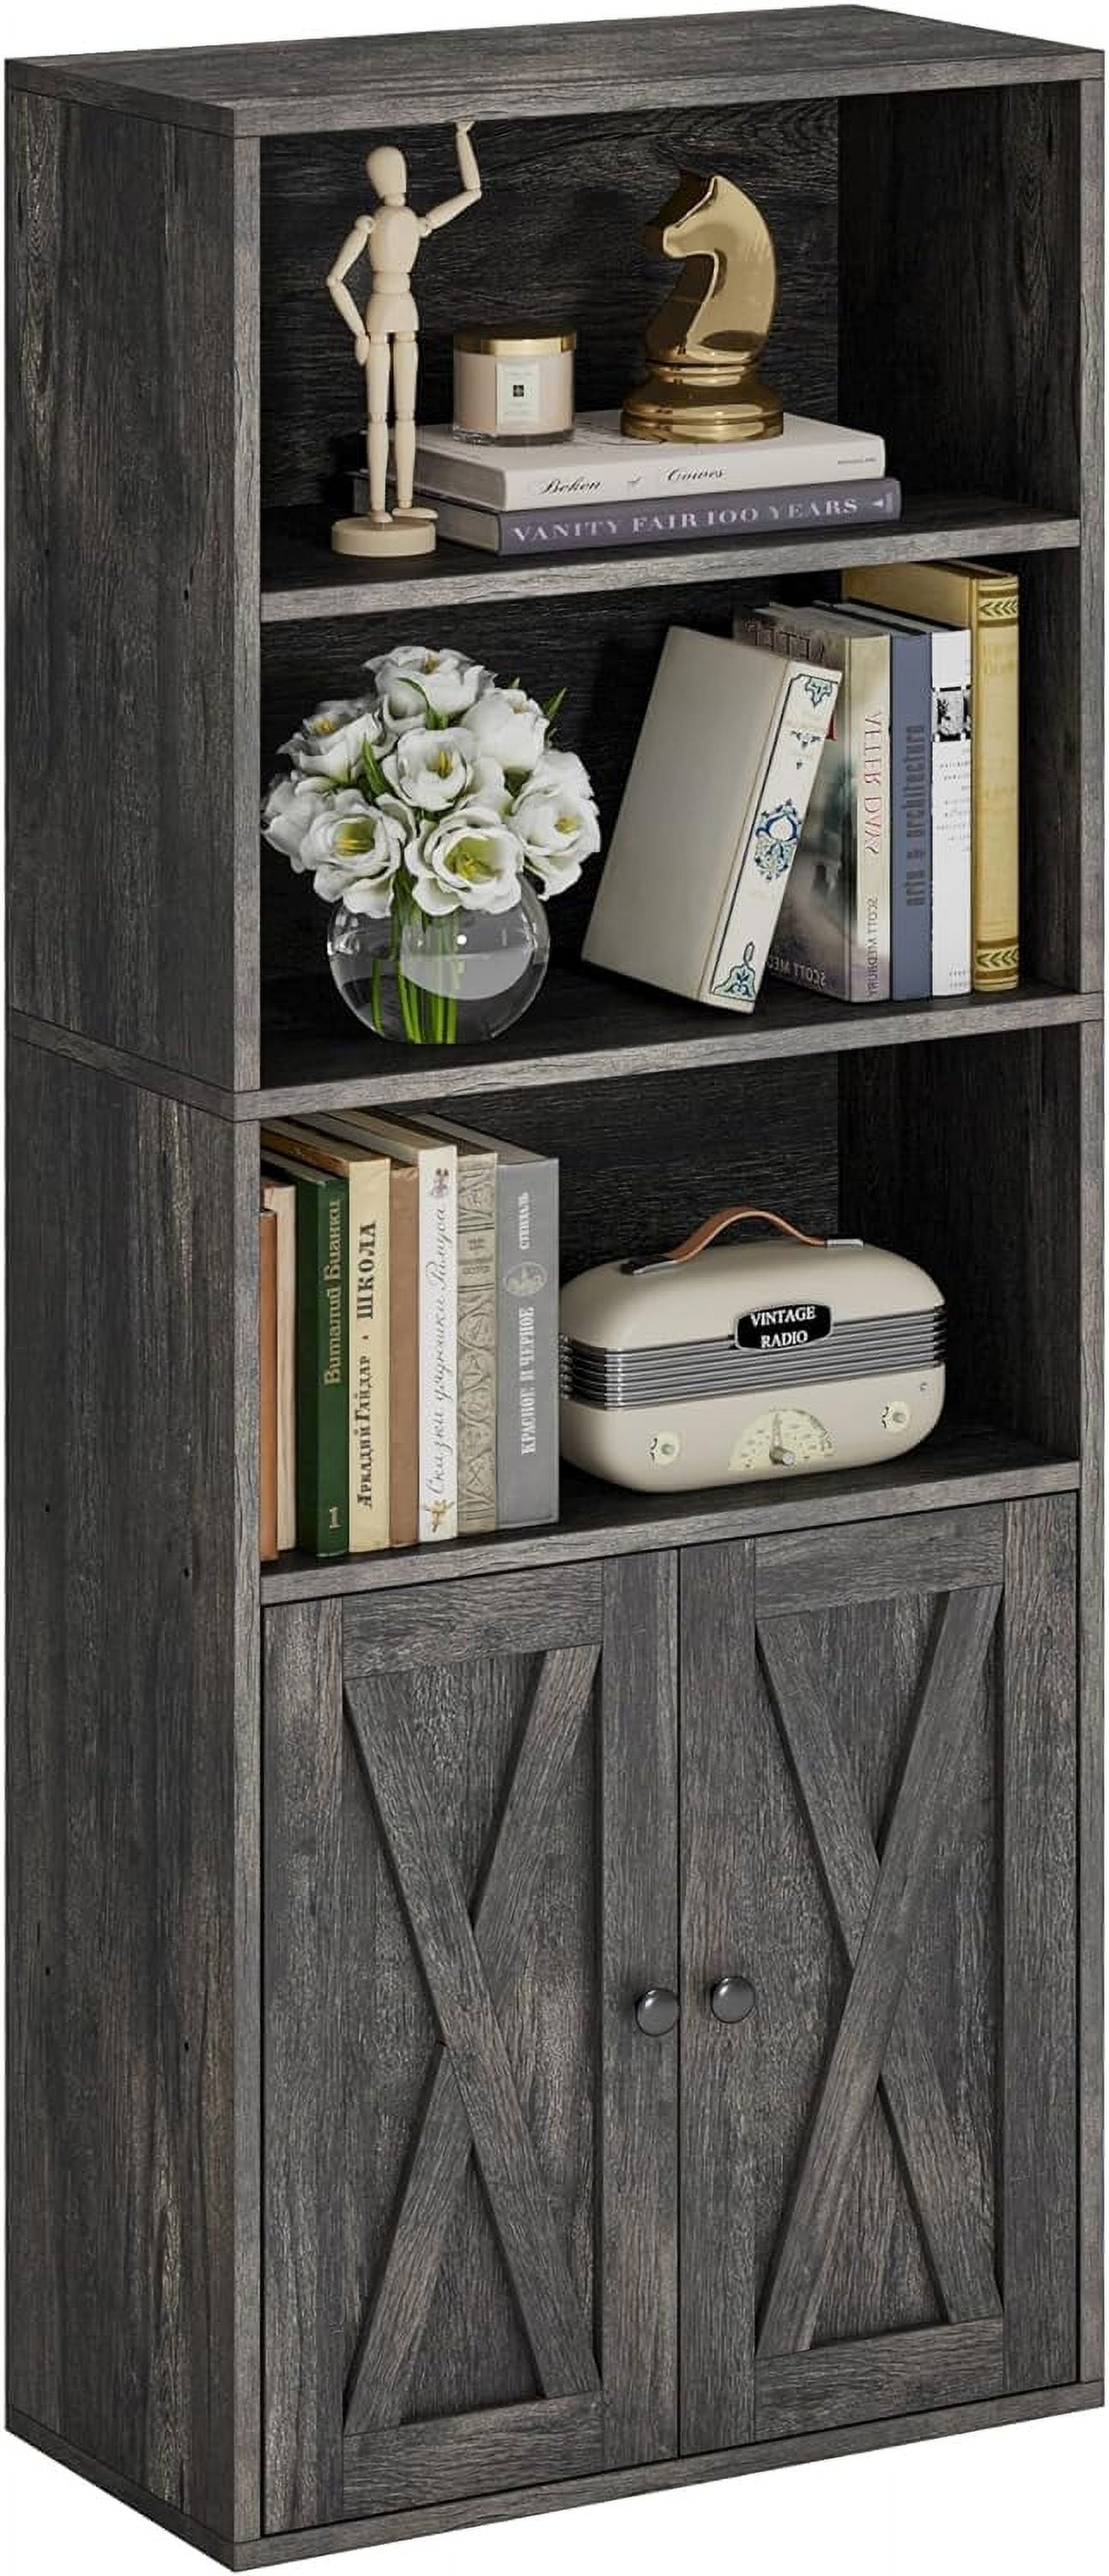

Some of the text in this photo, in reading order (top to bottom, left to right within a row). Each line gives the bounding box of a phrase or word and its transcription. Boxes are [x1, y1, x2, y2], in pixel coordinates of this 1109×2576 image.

[513, 497, 858, 543] VANITY FAIR 100 YEARS
[903, 726, 925, 839] architecture
[904, 869, 925, 907] arts
[355, 1219, 378, 1320] ШКОЛА
[323, 1199, 343, 1385] Виталий Бианки
[519, 1305, 536, 1368] ЧЕРНОЕ
[749, 1305, 816, 1327] VINTAGE
[761, 1330, 808, 1349] RADIO
[520, 1370, 537, 1382] И
[329, 1506, 341, 1530] 1
